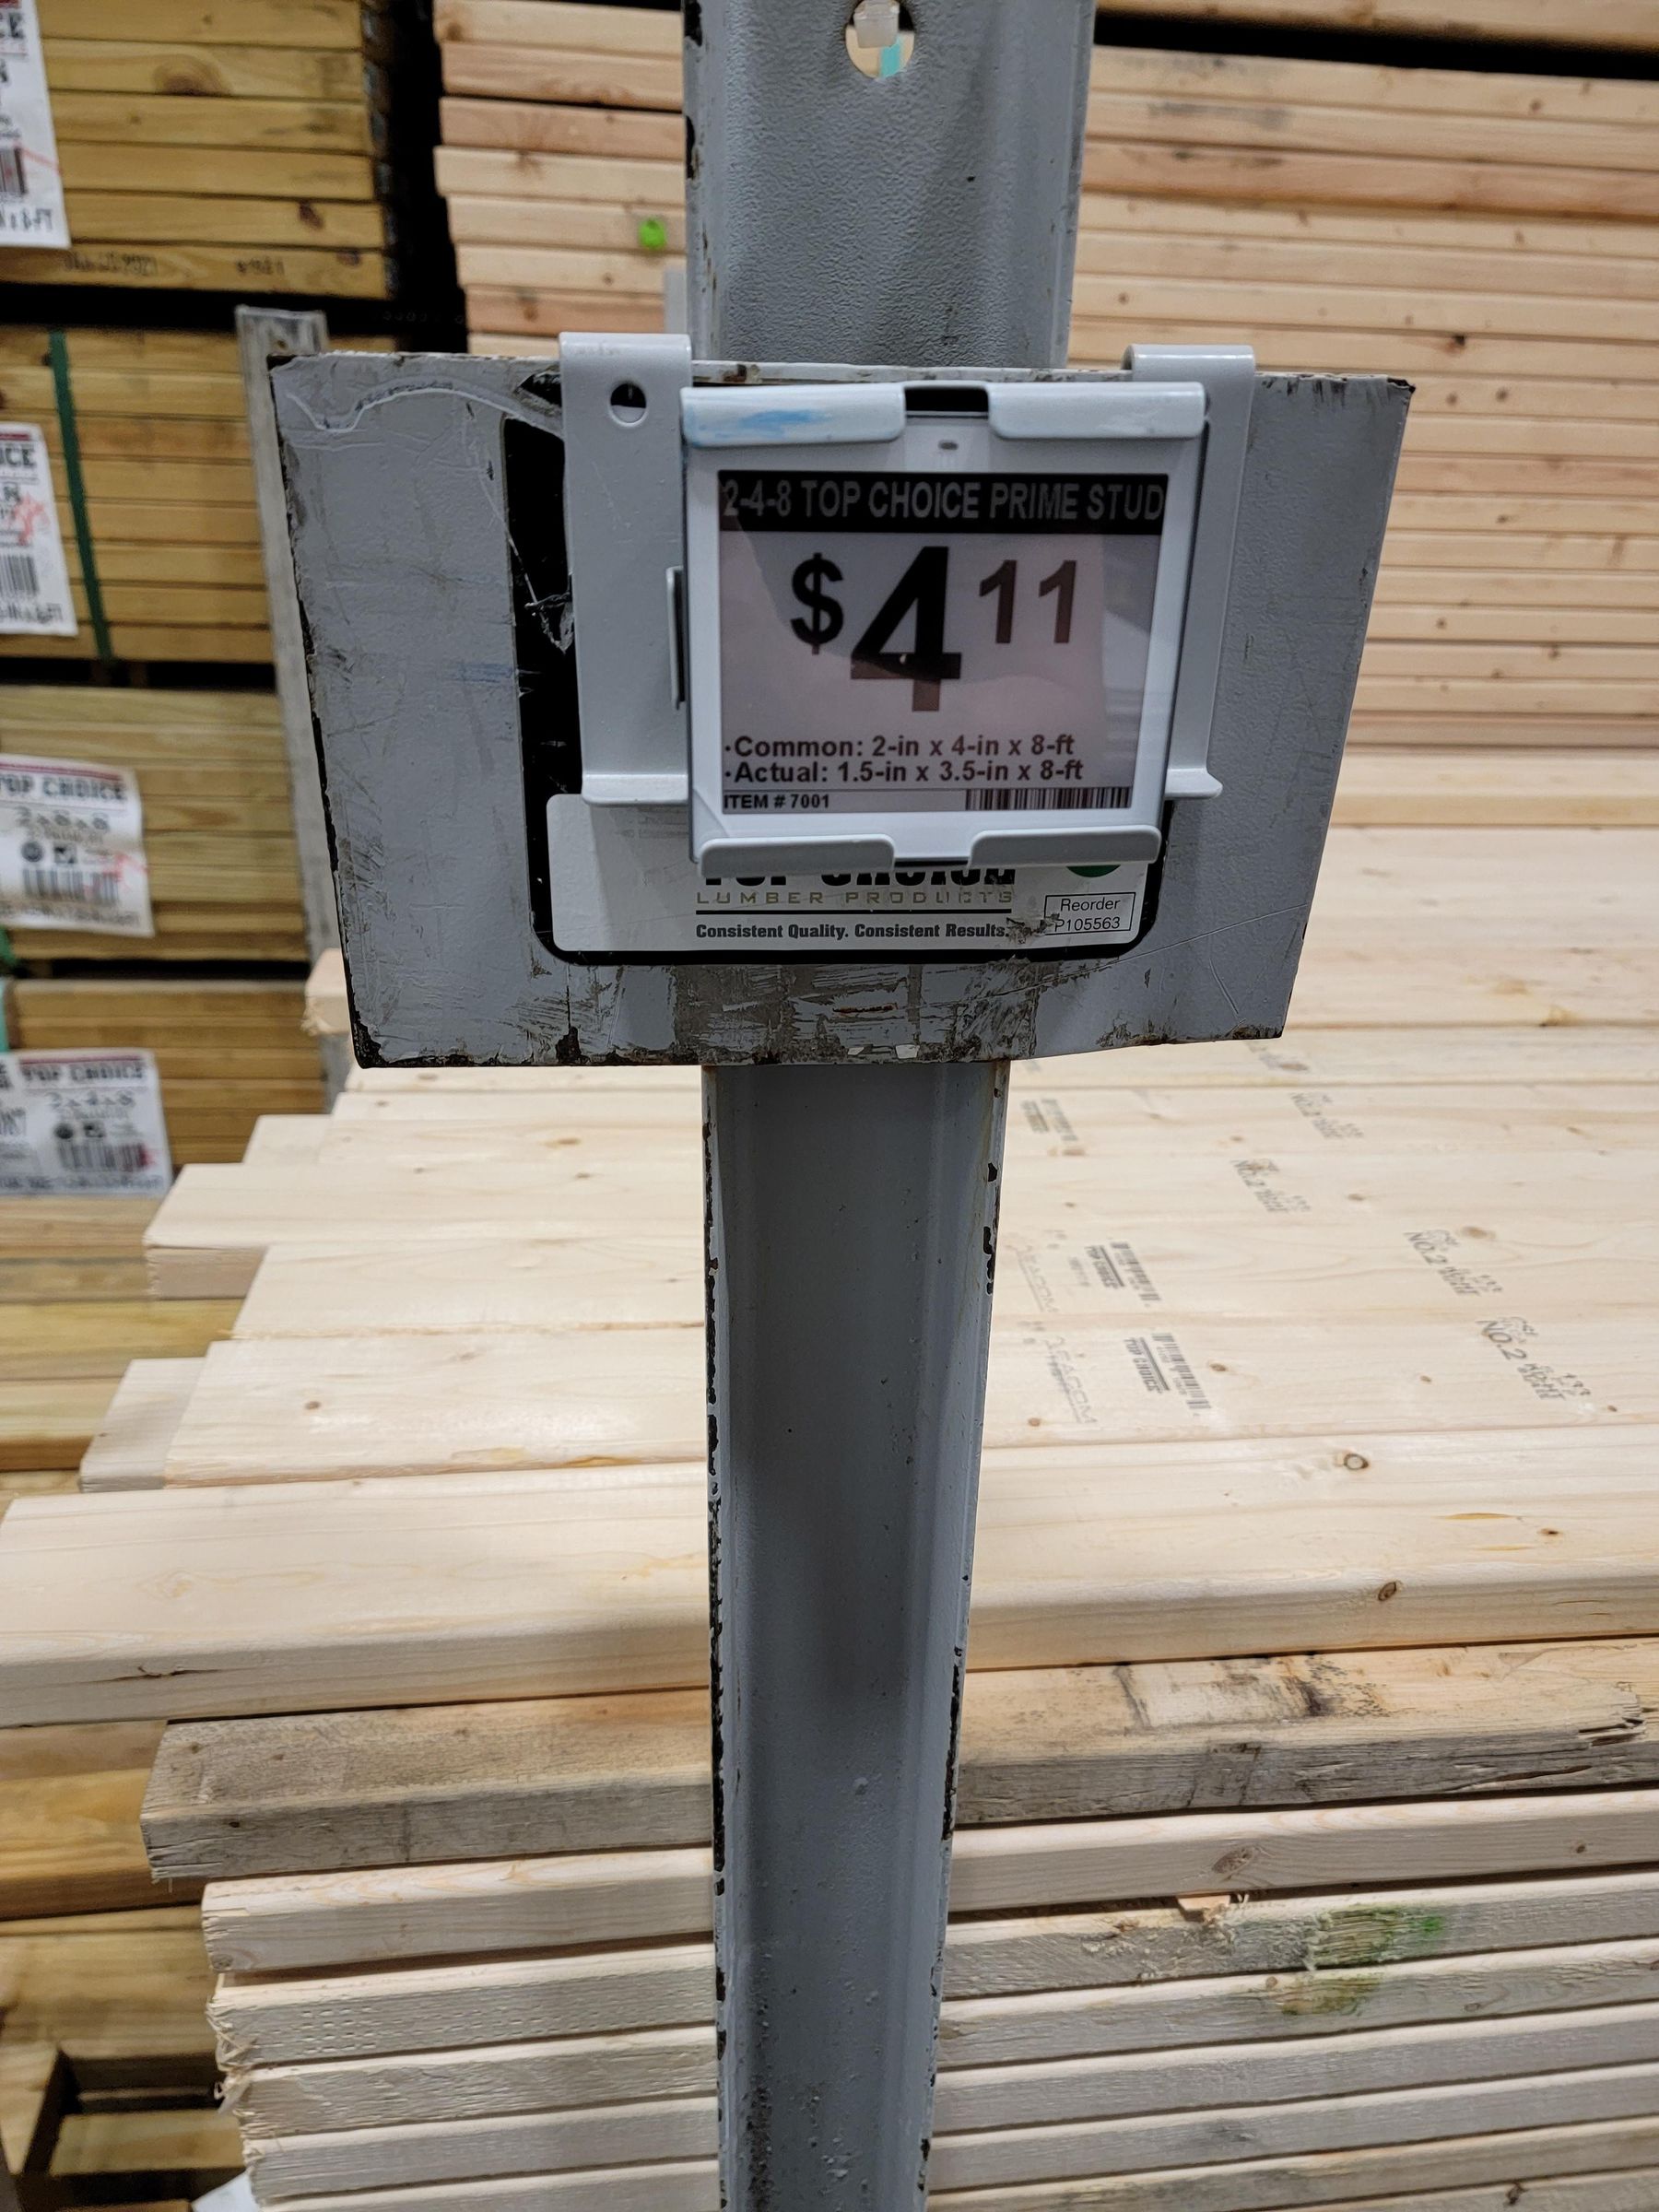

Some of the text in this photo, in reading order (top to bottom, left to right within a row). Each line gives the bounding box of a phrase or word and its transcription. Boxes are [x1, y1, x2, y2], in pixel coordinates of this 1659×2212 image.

[723, 479, 1164, 521] 2-4-8 TOP CHOICE PRIME STUD
[872, 735, 919, 757] 2-in
[929, 740, 943, 756] x
[951, 735, 999, 756] 4-in
[1008, 739, 1021, 756] x
[1031, 735, 1075, 755] 8-ft
[838, 760, 906, 782] 1.5-in
[915, 765, 929, 782] x
[940, 760, 1008, 782] 3.5-in
[1018, 764, 1031, 781] x
[1041, 759, 1084, 781] 8-ft
[724, 794, 769, 809] ITEM
[791, 794, 830, 808] 7001
[697, 891, 1012, 904] LUMBER PRODUCTS
[1061, 897, 1121, 912] Reorder
[696, 922, 1010, 941] Consistent Quality. Consistent Results.
[1054, 916, 1121, 933] P105563
[1476, 1320, 1527, 1360] NO.2
